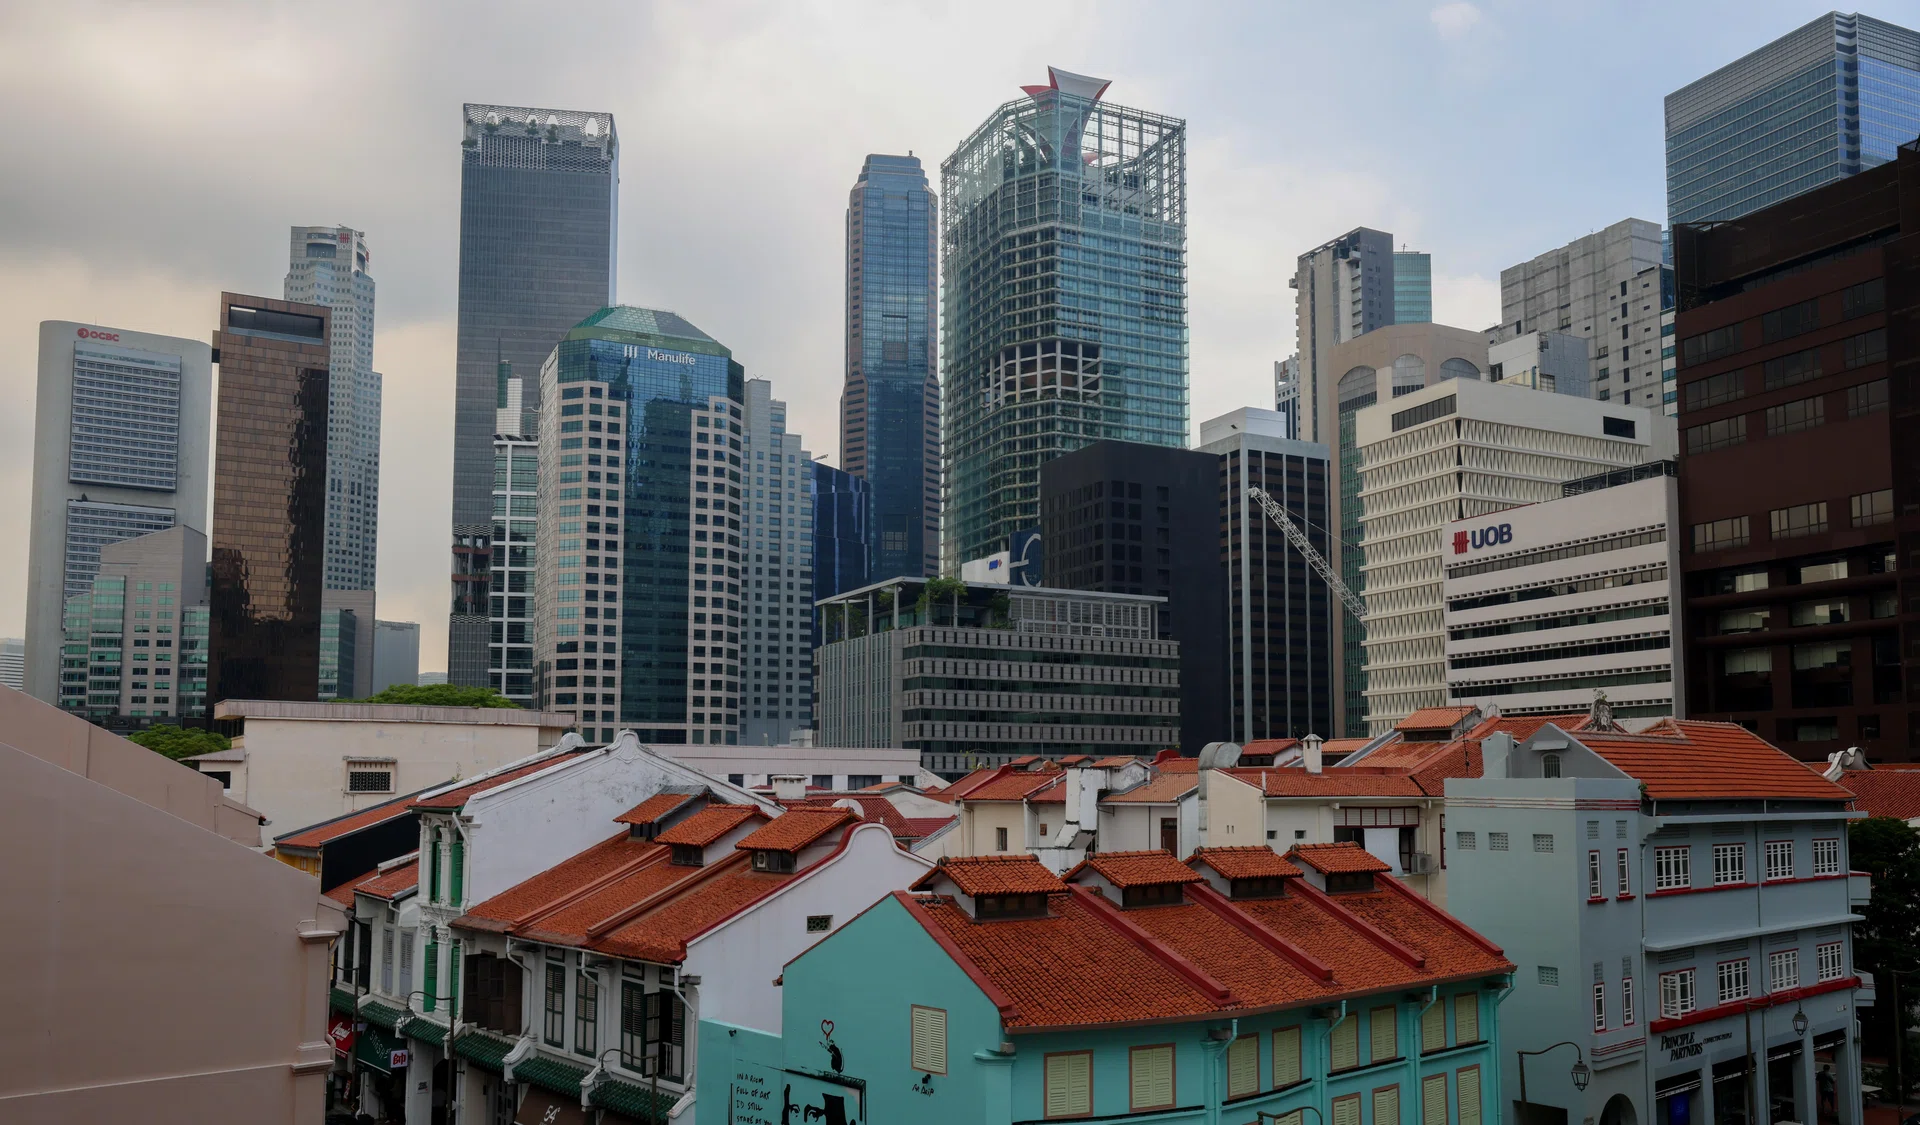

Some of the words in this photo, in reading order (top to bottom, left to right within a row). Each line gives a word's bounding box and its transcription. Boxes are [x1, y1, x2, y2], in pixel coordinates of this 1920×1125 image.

[90, 331, 120, 342] OCBC
[648, 349, 696, 365] Manulife
[1471, 523, 1513, 549] UOB
[1670, 1042, 1703, 1062] PARTNERS
[750, 1075, 764, 1086] ROOM
[736, 1086, 748, 1095] FULL
[751, 1089, 758, 1098] OF
[748, 1102, 764, 1111] STILL
[736, 1116, 754, 1124] STARE
